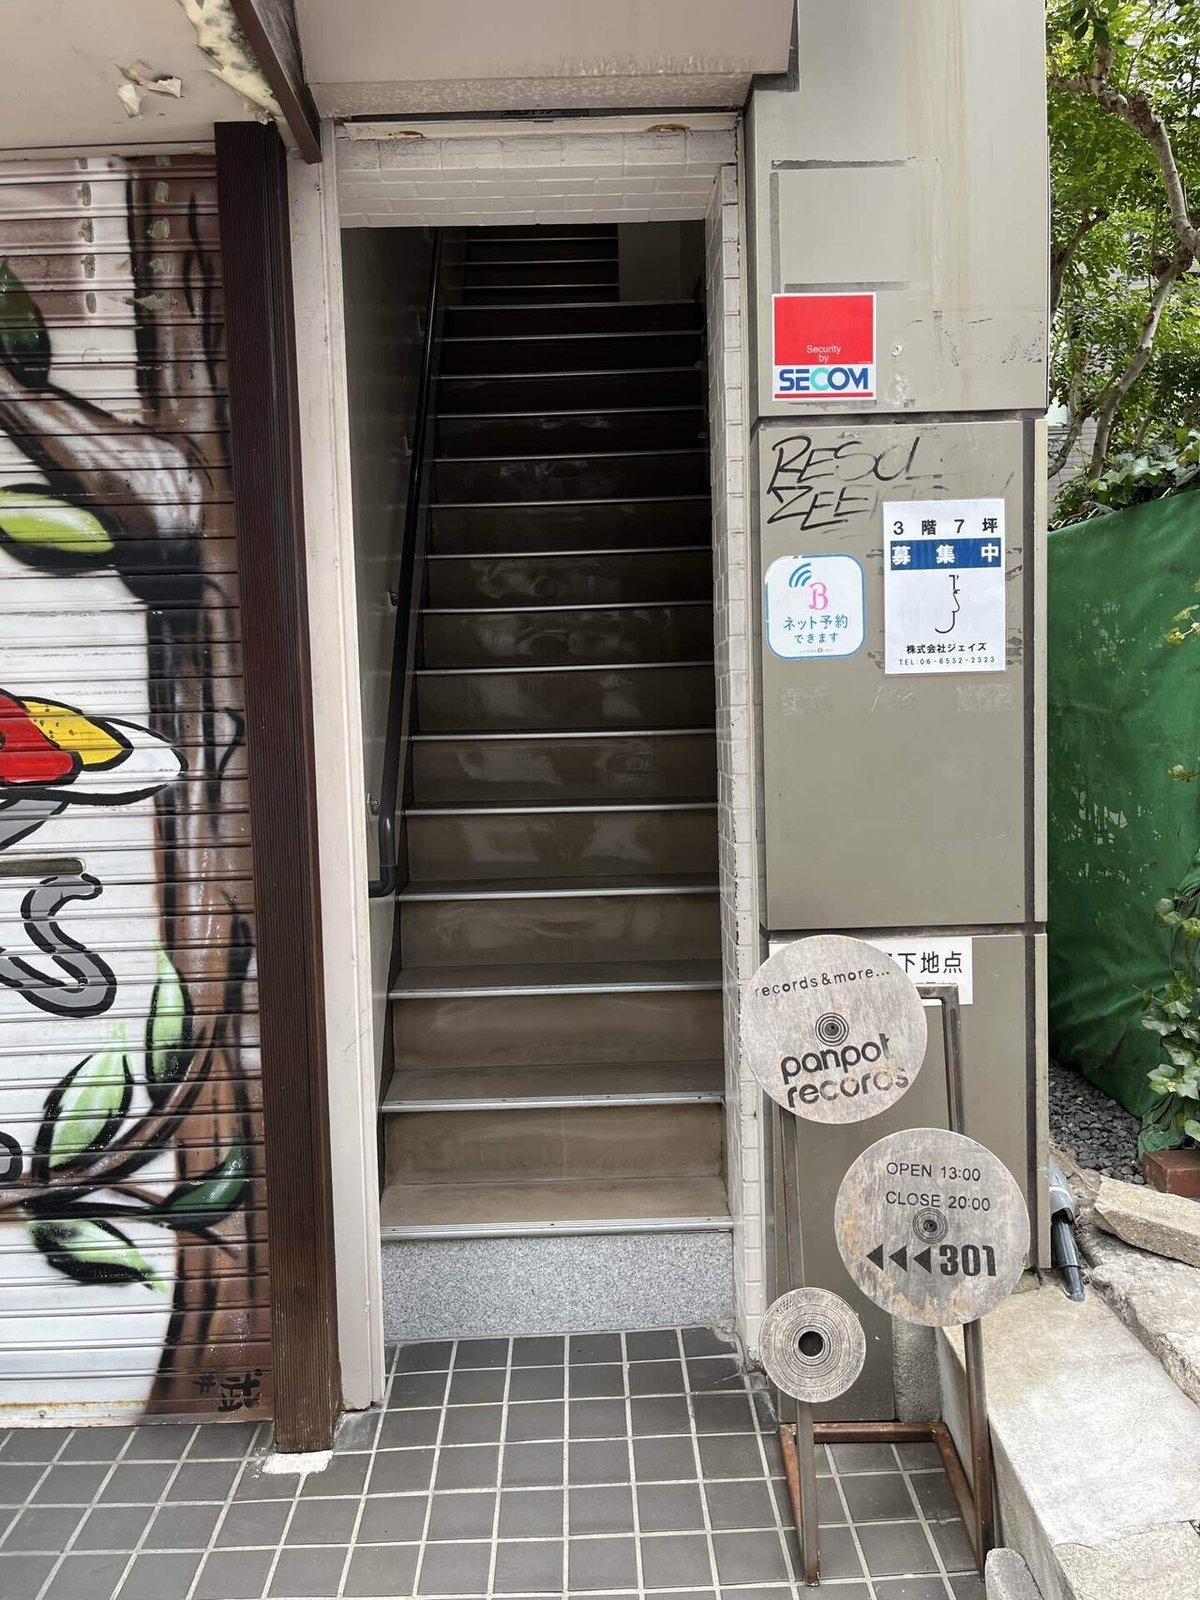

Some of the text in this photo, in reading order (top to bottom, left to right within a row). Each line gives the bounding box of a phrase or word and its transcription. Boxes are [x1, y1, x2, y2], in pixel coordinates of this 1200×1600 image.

[806, 344, 841, 355] Security
[818, 354, 829, 363] by
[779, 367, 869, 391] SECOM
[892, 543, 999, 565] 募集中
[783, 614, 848, 631] ネット予約
[794, 632, 839, 644] できます
[906, 642, 987, 654] 株式会社ジェイズ
[886, 950, 963, 974] 下地点
[780, 1032, 889, 1085] panpot
[886, 1162, 981, 1182] OPEN 13:00
[886, 1191, 991, 1212] CLOSE 20:00
[939, 1244, 997, 1277] 301
